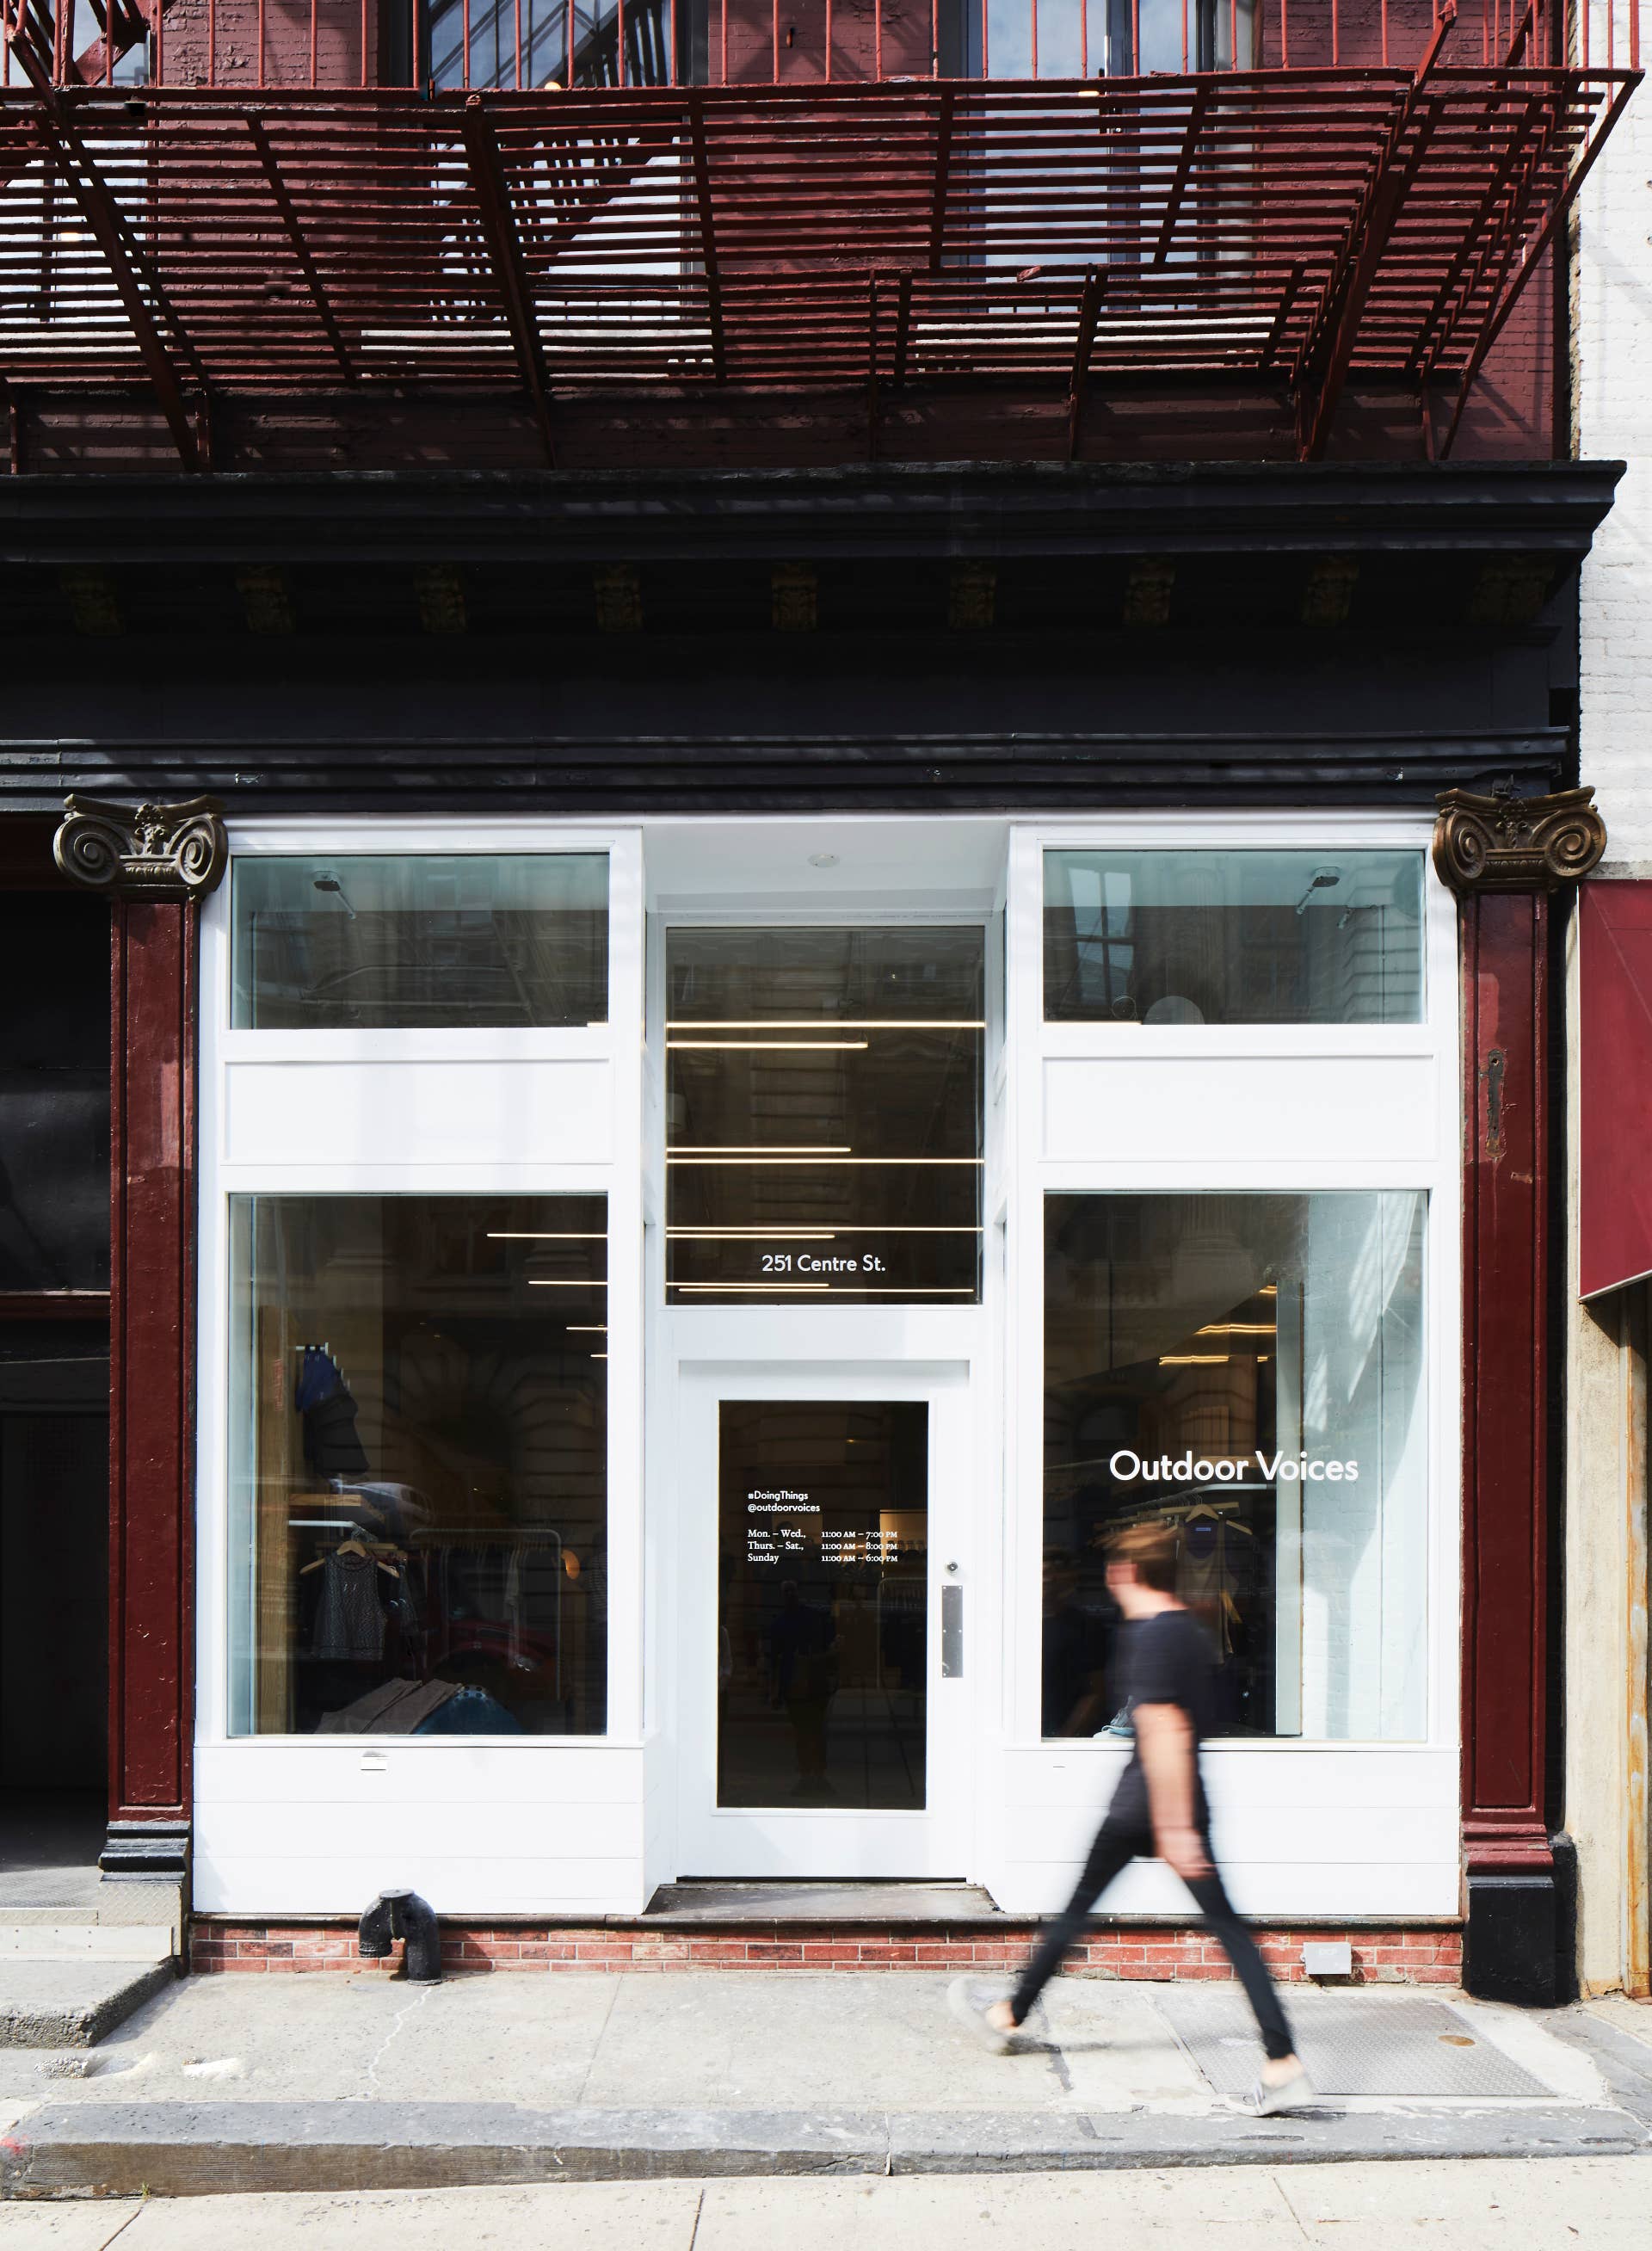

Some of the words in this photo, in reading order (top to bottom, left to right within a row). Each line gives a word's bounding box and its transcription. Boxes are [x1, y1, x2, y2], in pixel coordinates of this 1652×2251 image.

[761, 1255, 792, 1272] 251
[797, 1254, 858, 1272] Centre
[862, 1254, 886, 1272] St.
[1109, 1450, 1249, 1481] Outdoor
[1255, 1450, 1359, 1481] Voices
[747, 1489, 809, 1502] #DoingThings
[747, 1502, 821, 1514] @outdoorvoices
[747, 1528, 771, 1538] Mon.
[747, 1540, 776, 1550] Thurs.
[747, 1552, 780, 1564] Sunday
